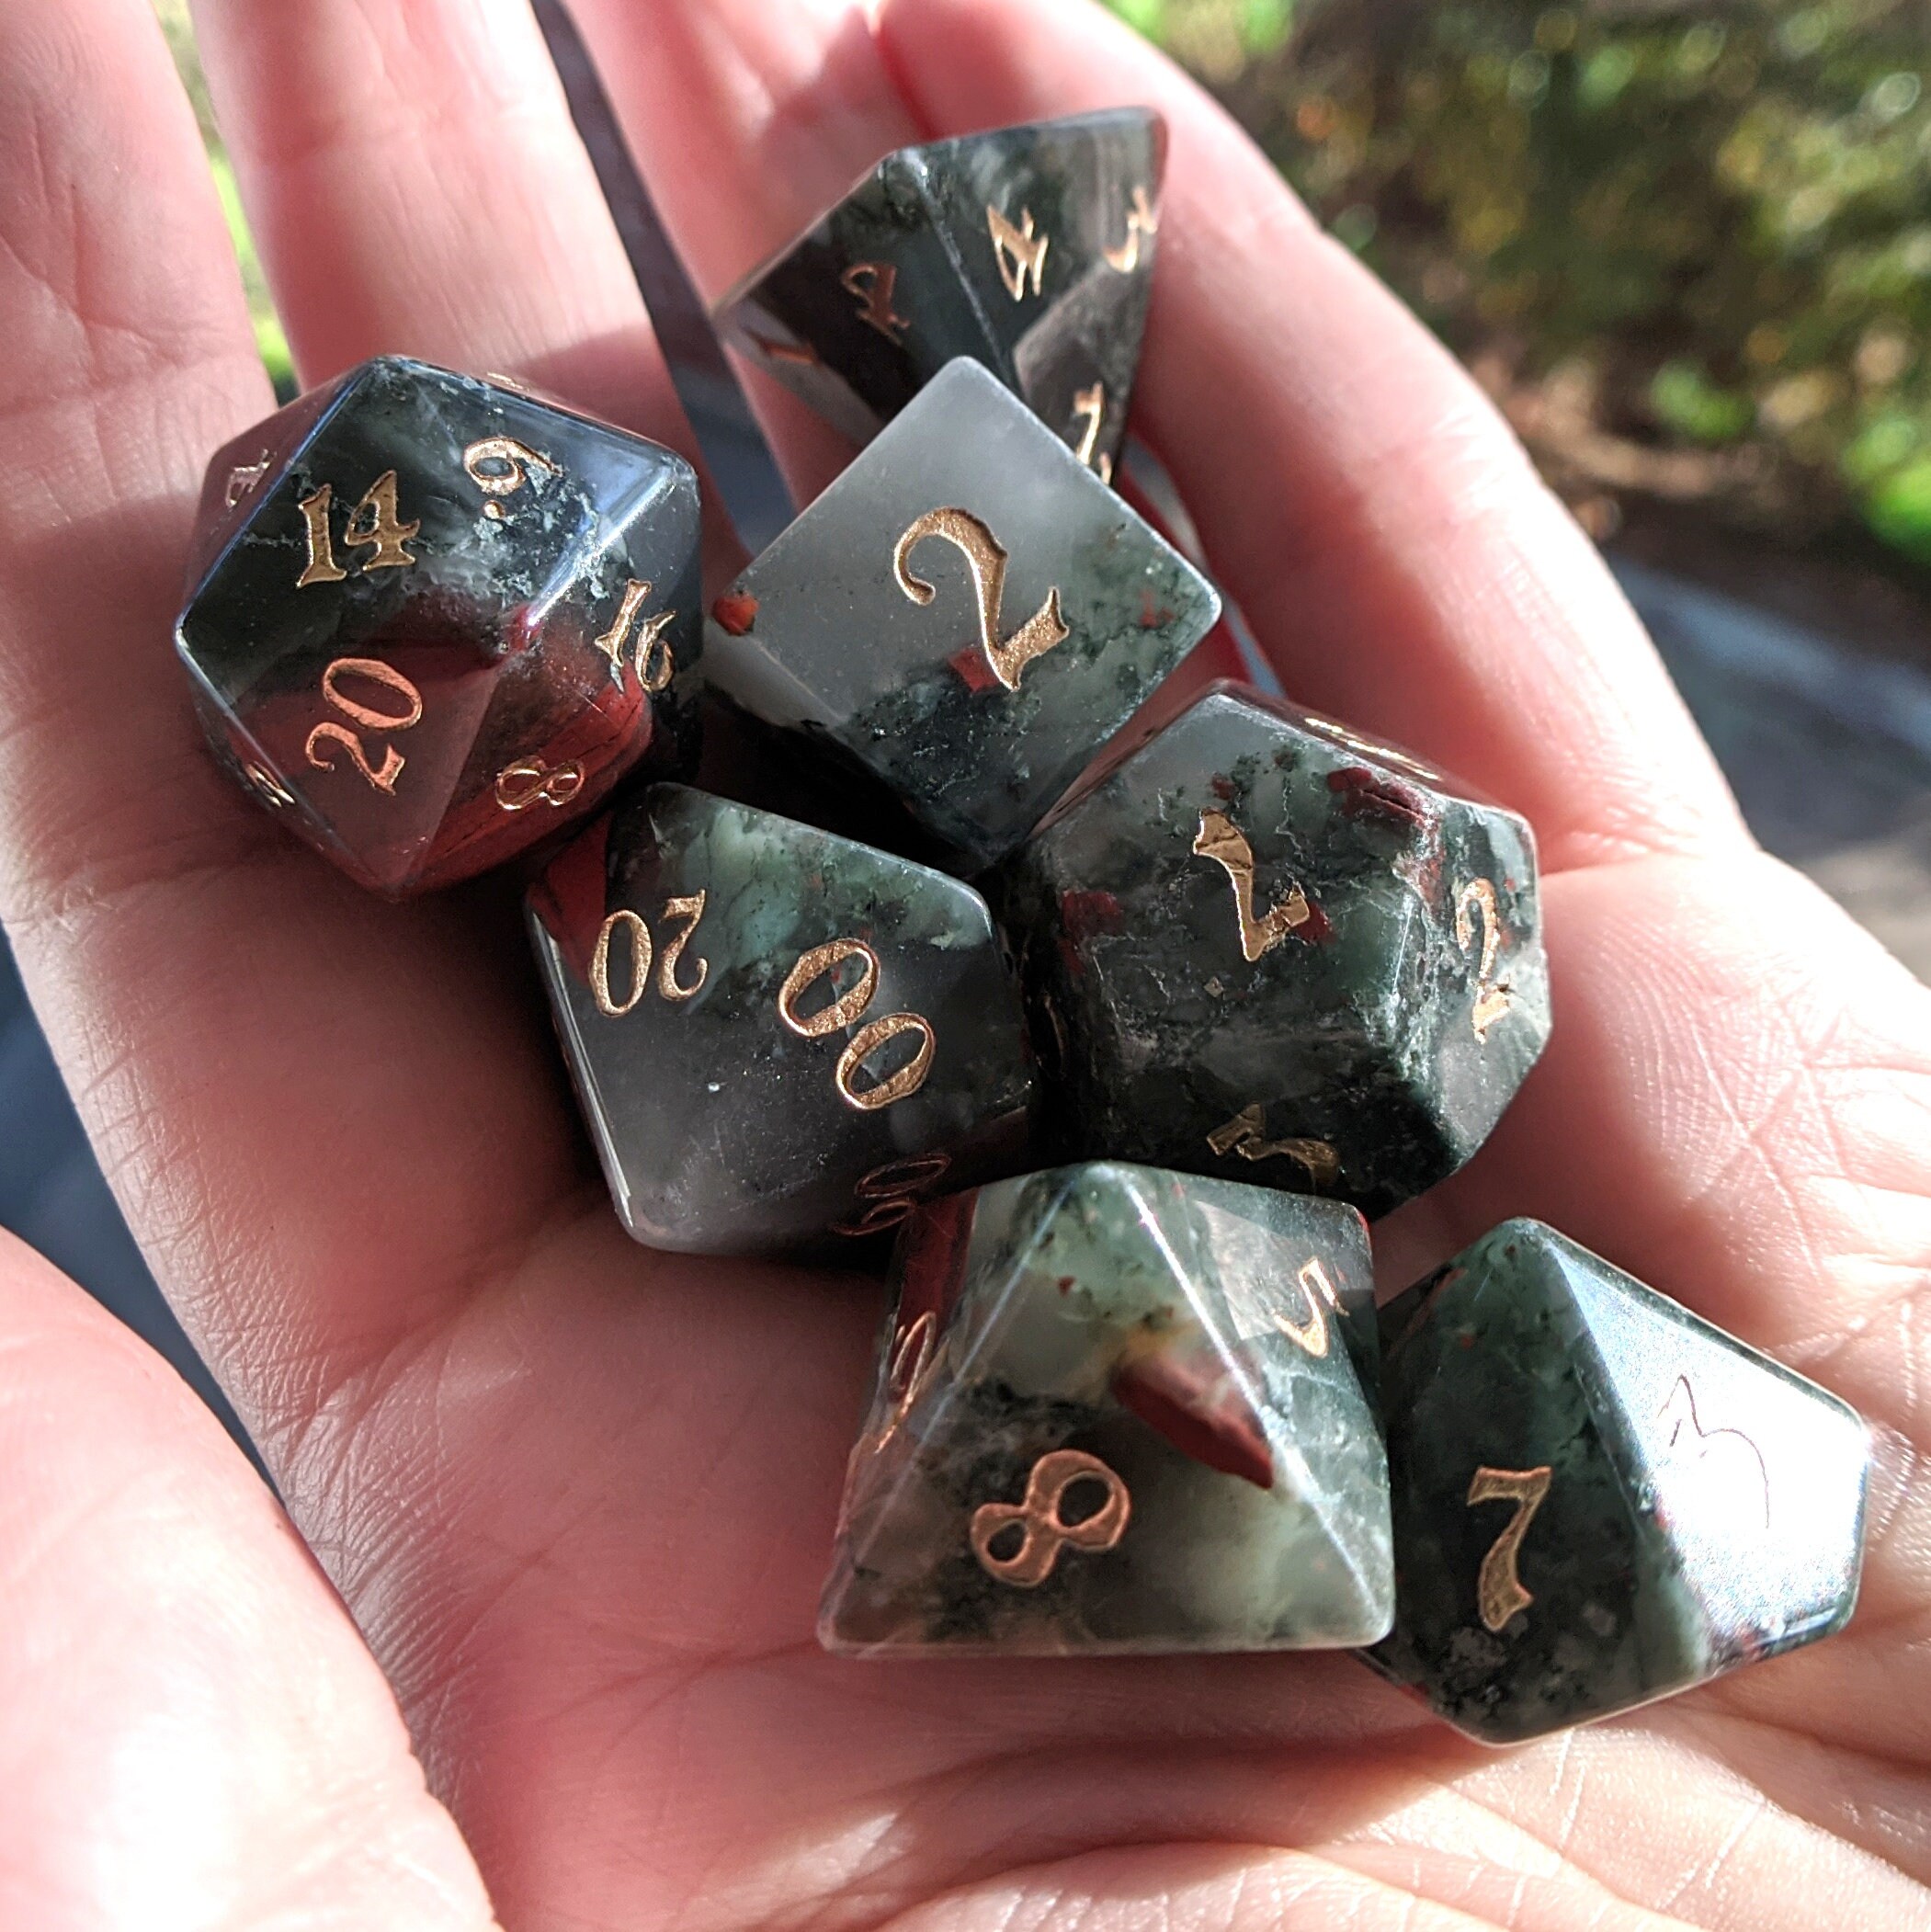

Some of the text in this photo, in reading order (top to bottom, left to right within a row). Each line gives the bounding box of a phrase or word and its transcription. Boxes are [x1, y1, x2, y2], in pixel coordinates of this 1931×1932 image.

[296, 469, 421, 589] 14
[893, 505, 1070, 691] 2
[594, 577, 676, 692] 16
[304, 657, 424, 797] 20
[494, 753, 586, 812] 8
[588, 888, 709, 1017] 20
[778, 937, 937, 1110] 00
[970, 1449, 1130, 1587] 8
[1466, 1465, 1552, 1632] 7
